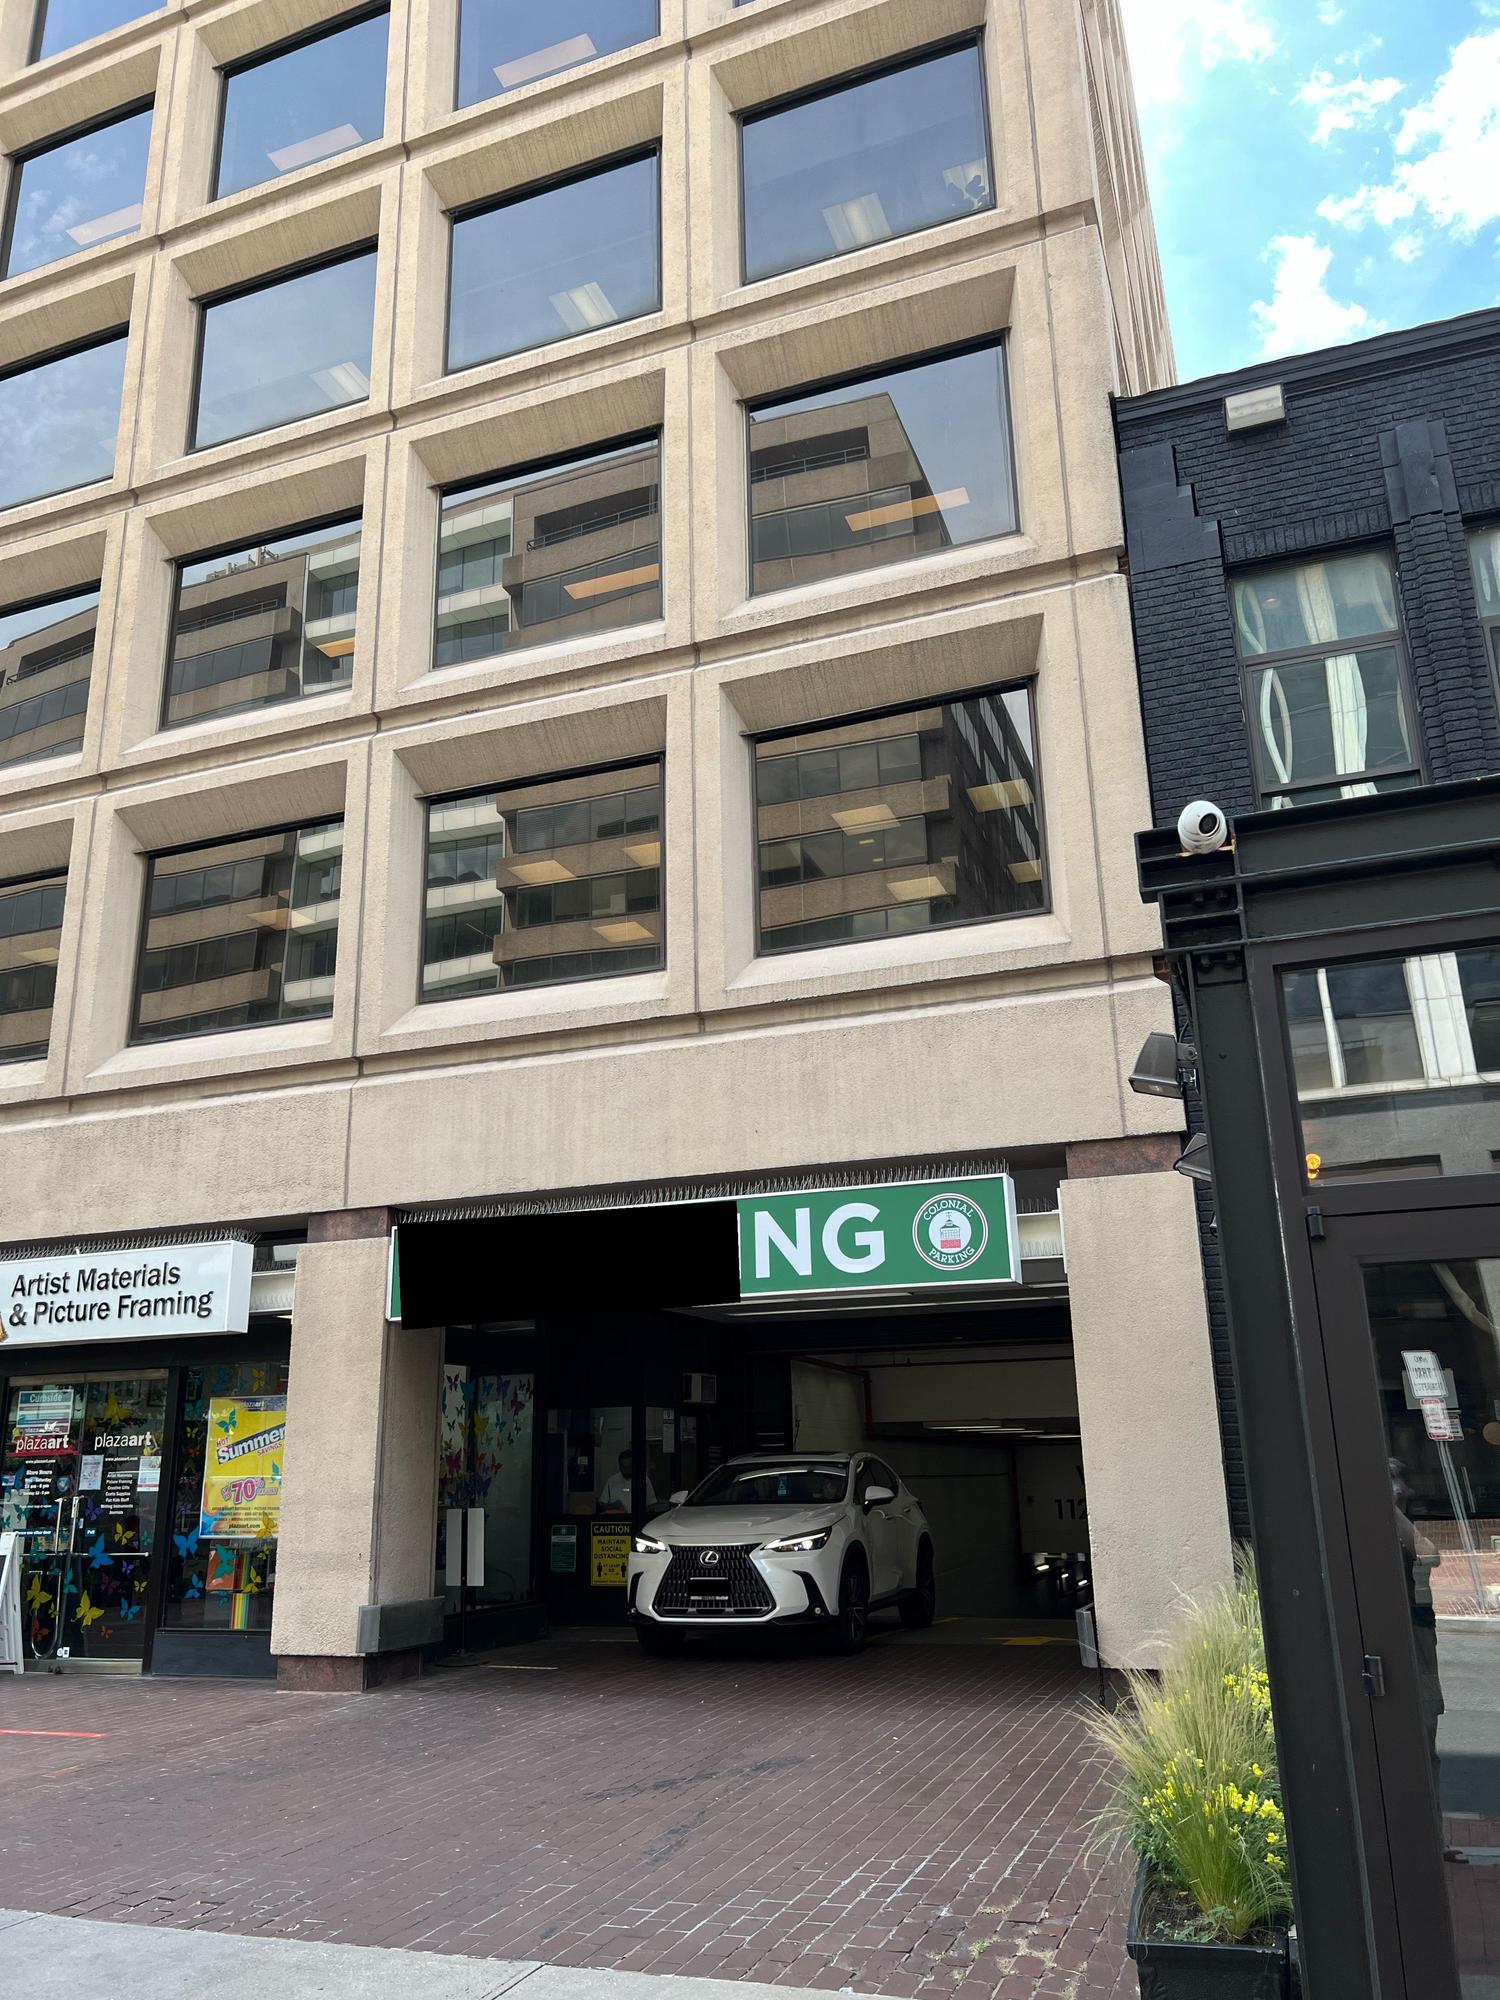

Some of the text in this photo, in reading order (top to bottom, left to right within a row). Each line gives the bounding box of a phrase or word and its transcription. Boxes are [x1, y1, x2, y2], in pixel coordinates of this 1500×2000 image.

[923, 1199, 974, 1221] COLONIAL
[737, 1202, 886, 1279] NG
[928, 1246, 976, 1264] PARKING
[11, 1262, 181, 1298] Artist Materials
[9, 1291, 214, 1327] & Picture Framing
[30, 1392, 63, 1403] Curbside
[15, 1434, 69, 1453] plazaart
[94, 1431, 153, 1451] plazaart
[217, 1426, 286, 1464] Summer
[593, 1525, 630, 1534] CAUTION
